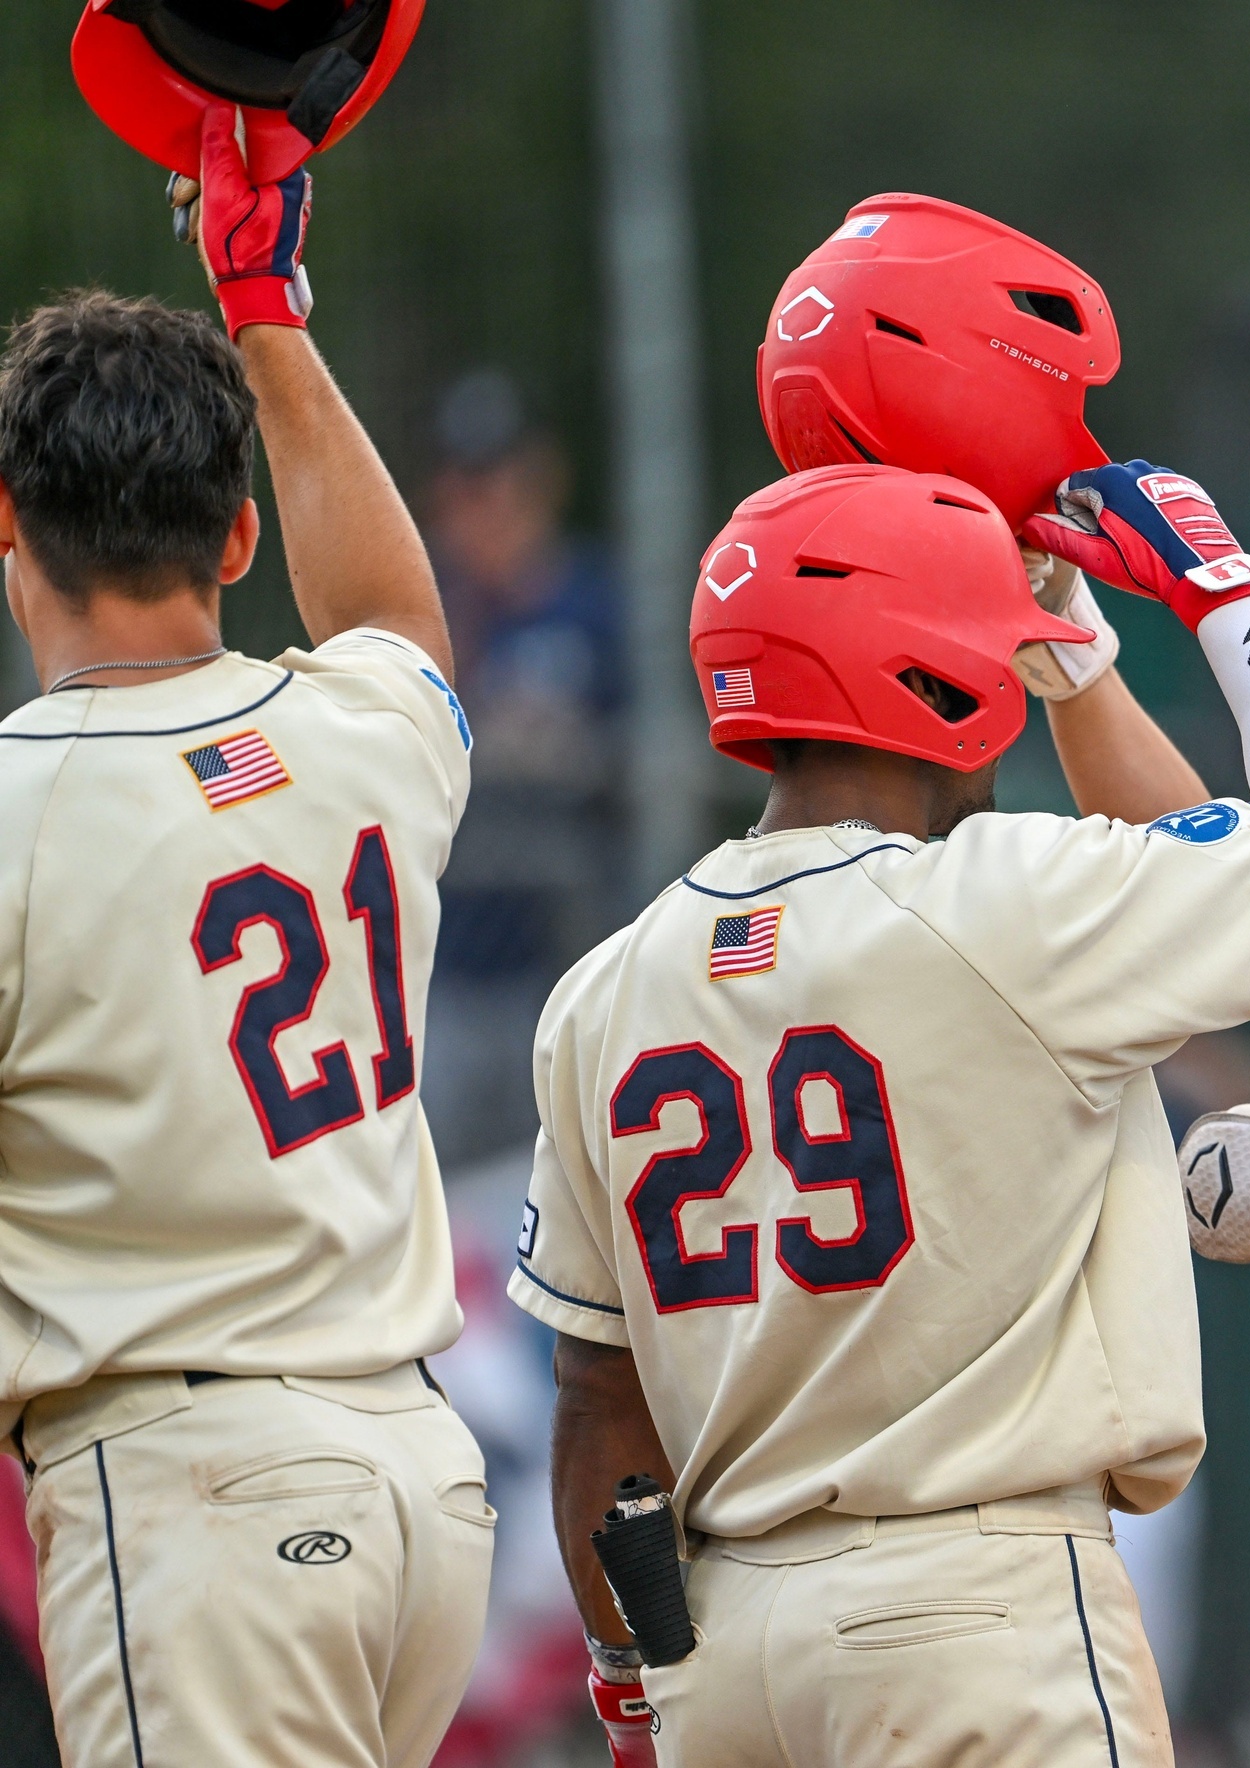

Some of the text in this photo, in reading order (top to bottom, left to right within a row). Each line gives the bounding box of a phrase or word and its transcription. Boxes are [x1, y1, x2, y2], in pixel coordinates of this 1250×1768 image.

[989, 338, 1069, 382] EVOSHIELD
[189, 823, 416, 1160] 21
[609, 1023, 916, 1315] 29
